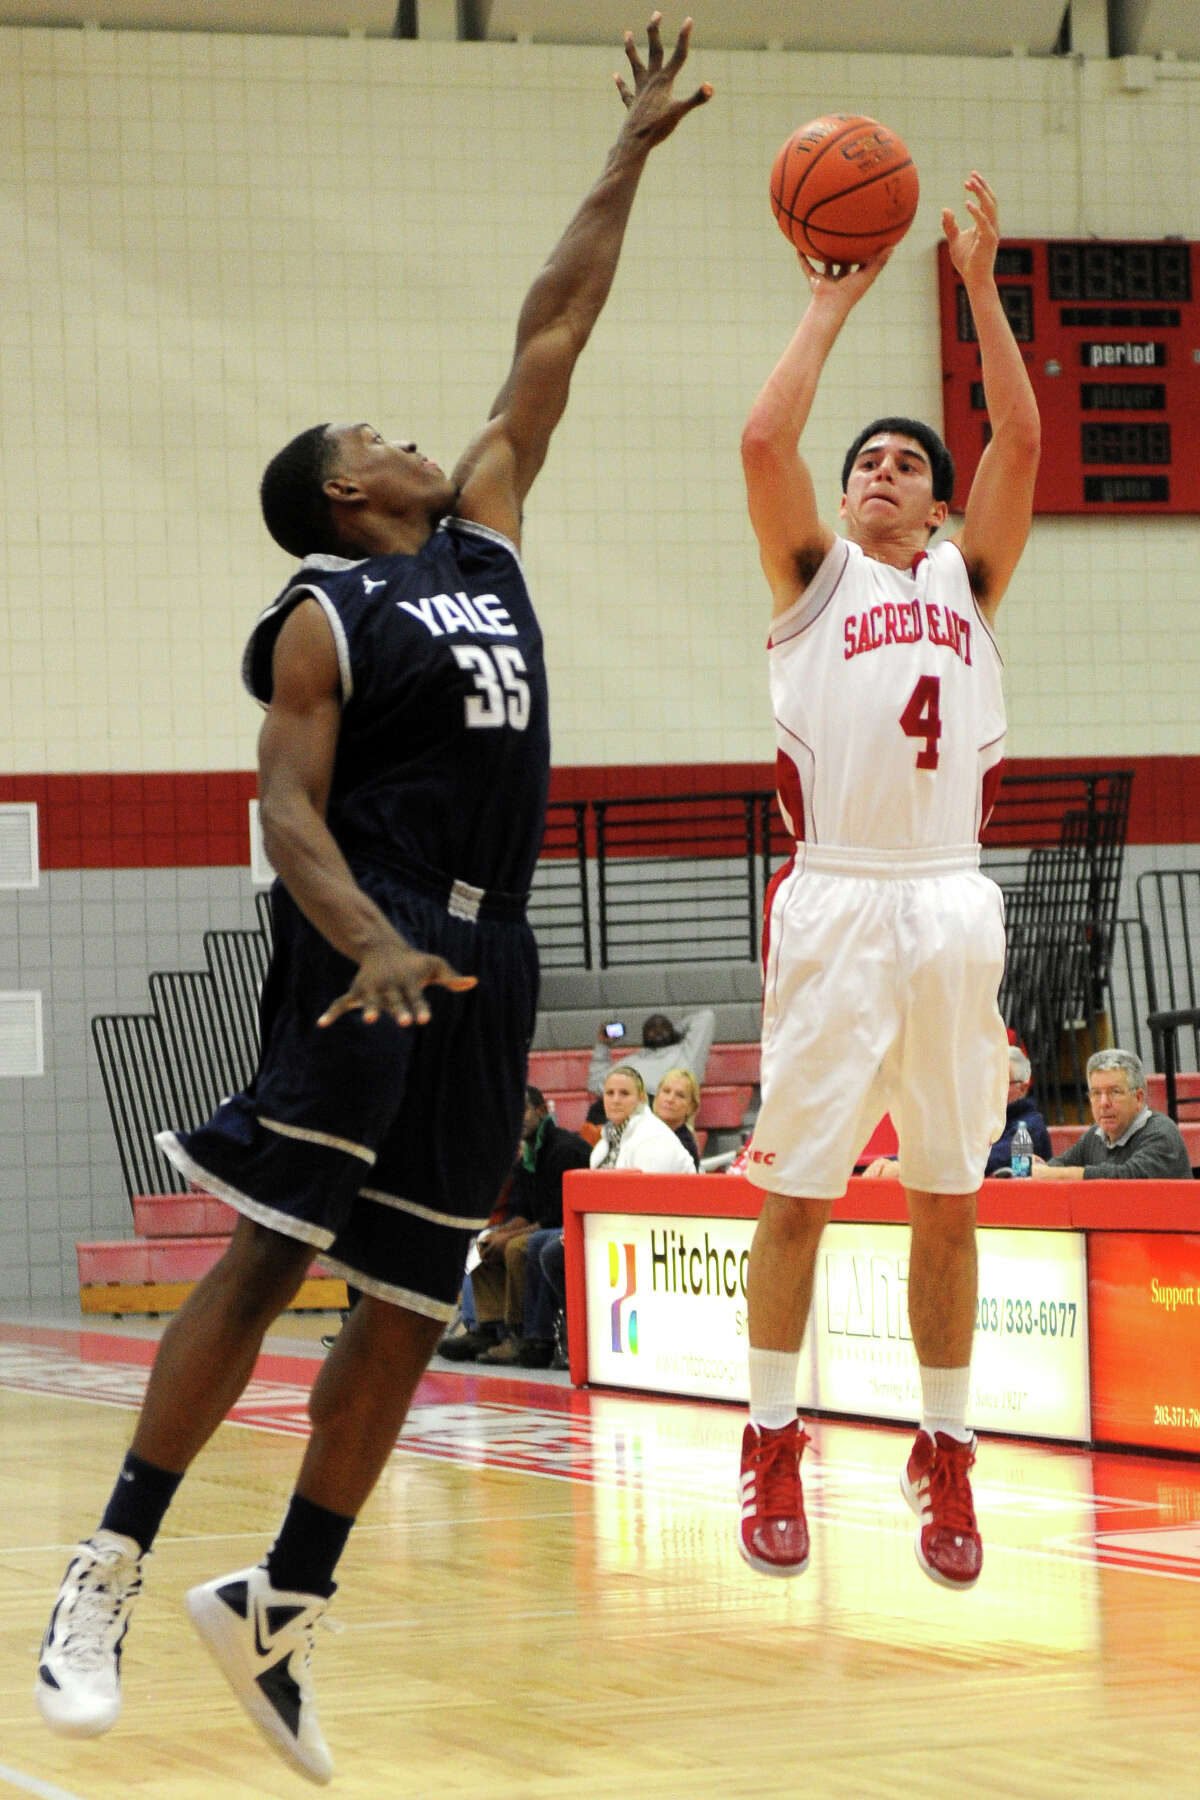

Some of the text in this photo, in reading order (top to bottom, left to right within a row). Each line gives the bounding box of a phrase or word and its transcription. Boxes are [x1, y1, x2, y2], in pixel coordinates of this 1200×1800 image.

[1090, 341, 1155, 367] period
[396, 591, 518, 637] YALE
[844, 599, 972, 667] SACRED EART
[450, 644, 531, 731] 35
[899, 675, 942, 770] 4
[748, 1150, 776, 1166] EC
[650, 1229, 749, 1299] Hitchco
[1152, 1278, 1195, 1312] Support
[1154, 1404, 1200, 1428] 203-371-78
